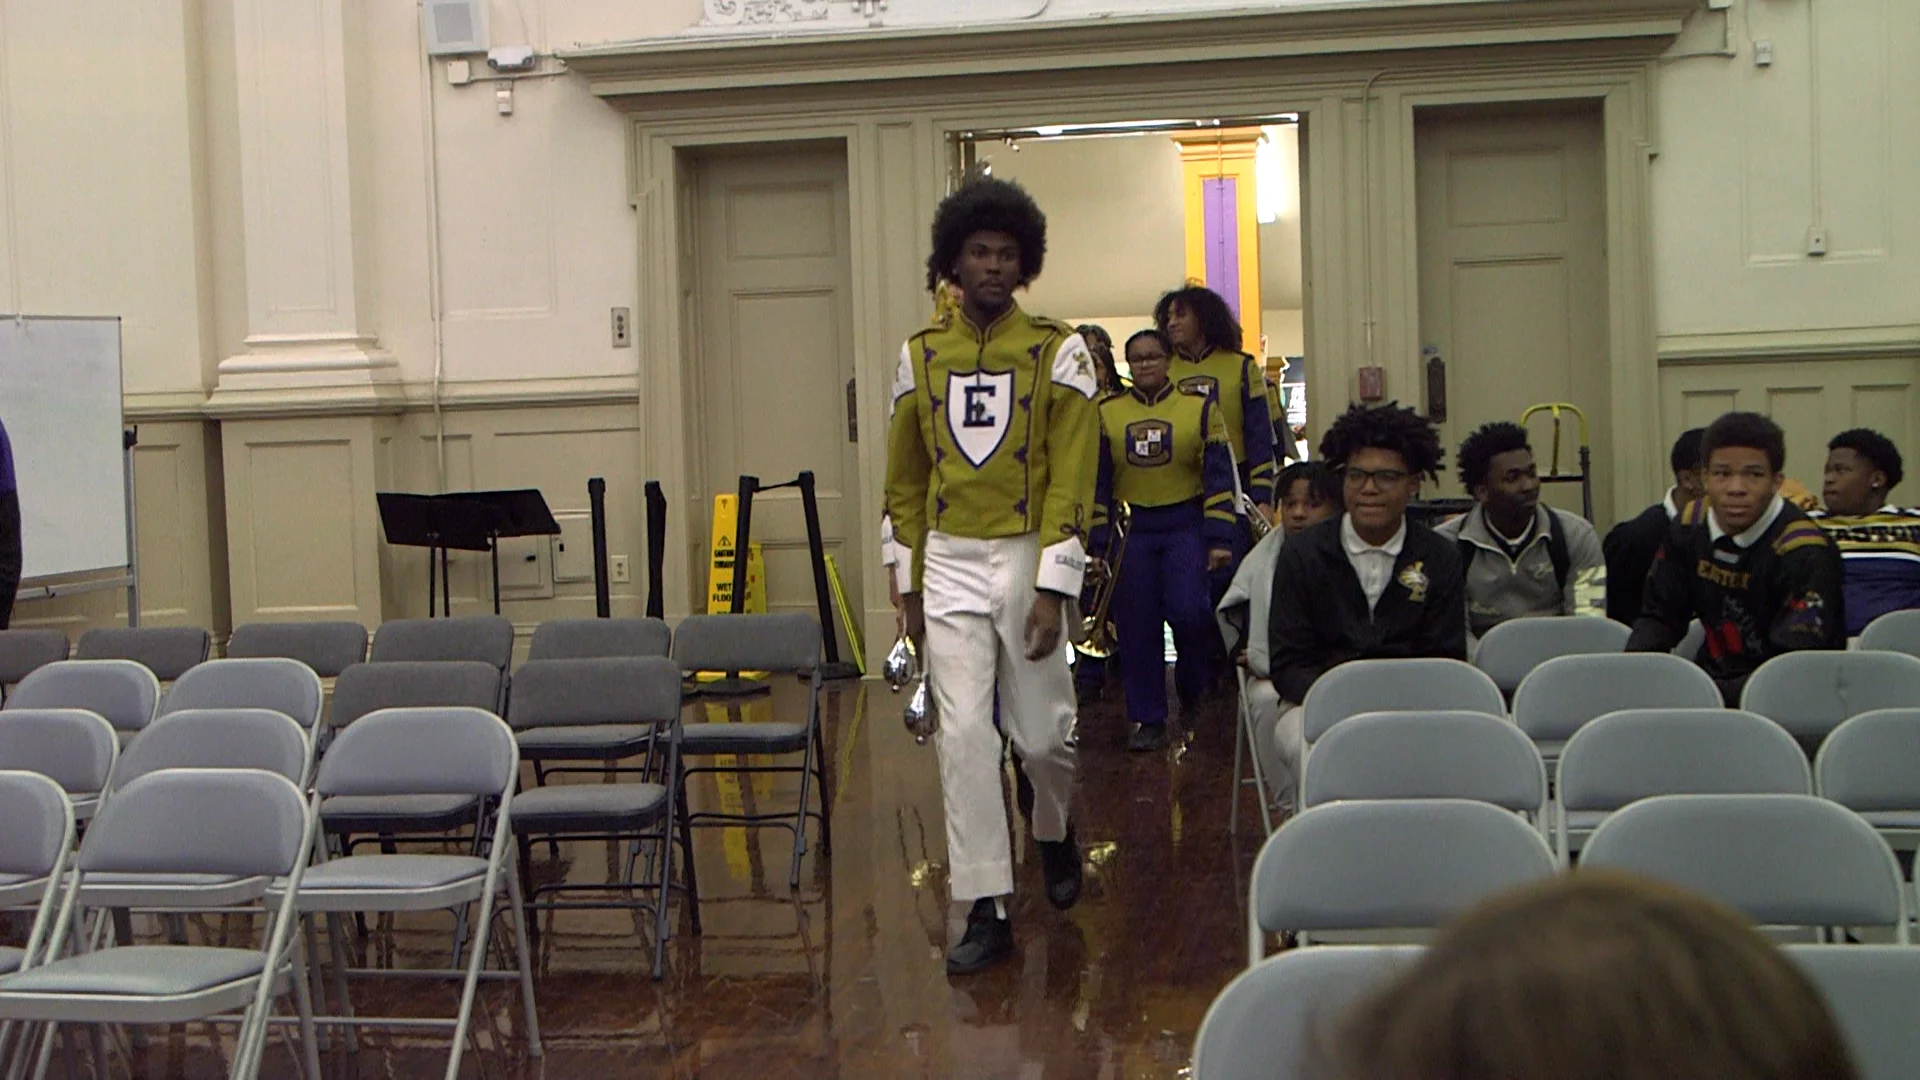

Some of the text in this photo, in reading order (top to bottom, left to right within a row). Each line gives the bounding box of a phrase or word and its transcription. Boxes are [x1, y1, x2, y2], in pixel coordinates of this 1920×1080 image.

[963, 385, 996, 427] E
[716, 583, 732, 592] WET
[713, 594, 732, 602] FLOO
